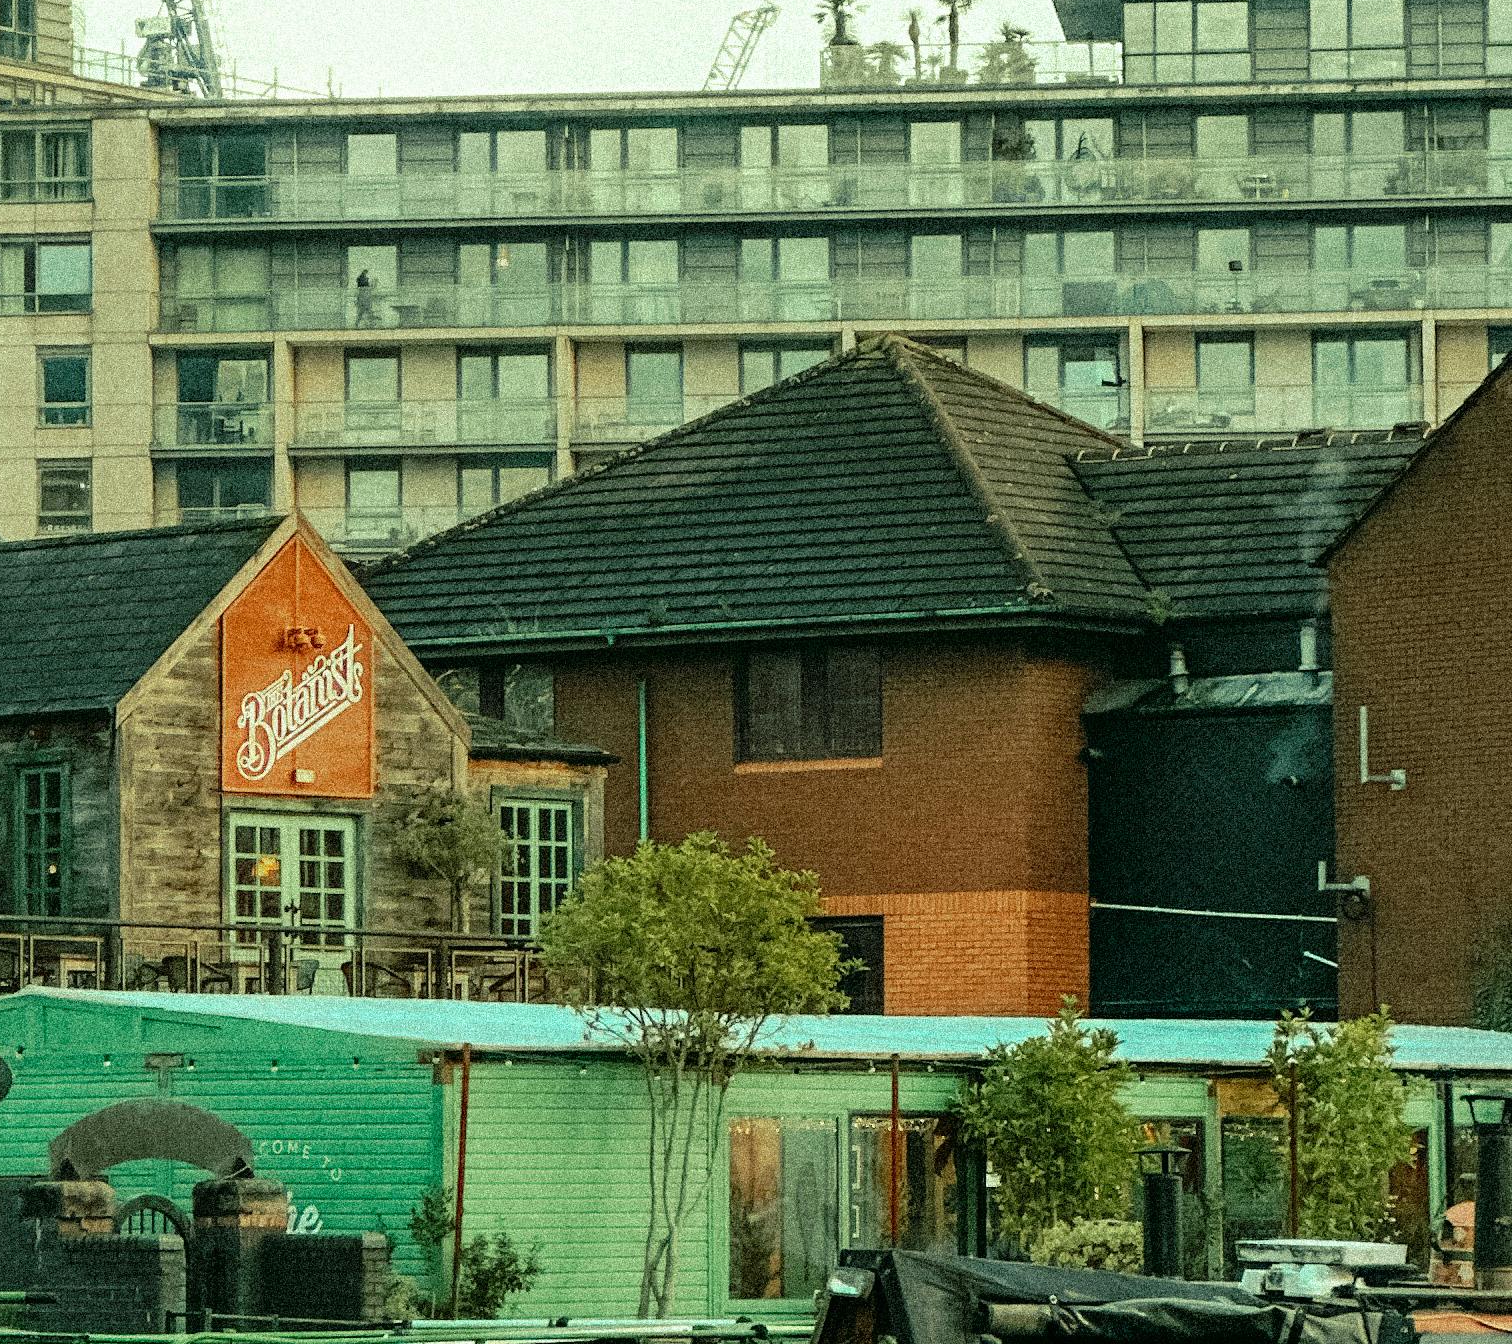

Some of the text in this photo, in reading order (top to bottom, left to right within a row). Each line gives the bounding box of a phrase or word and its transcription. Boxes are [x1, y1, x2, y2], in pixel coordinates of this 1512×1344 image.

[237, 623, 363, 781] Botanist
[255, 1140, 311, 1160] COME
[285, 1191, 324, 1235] he
